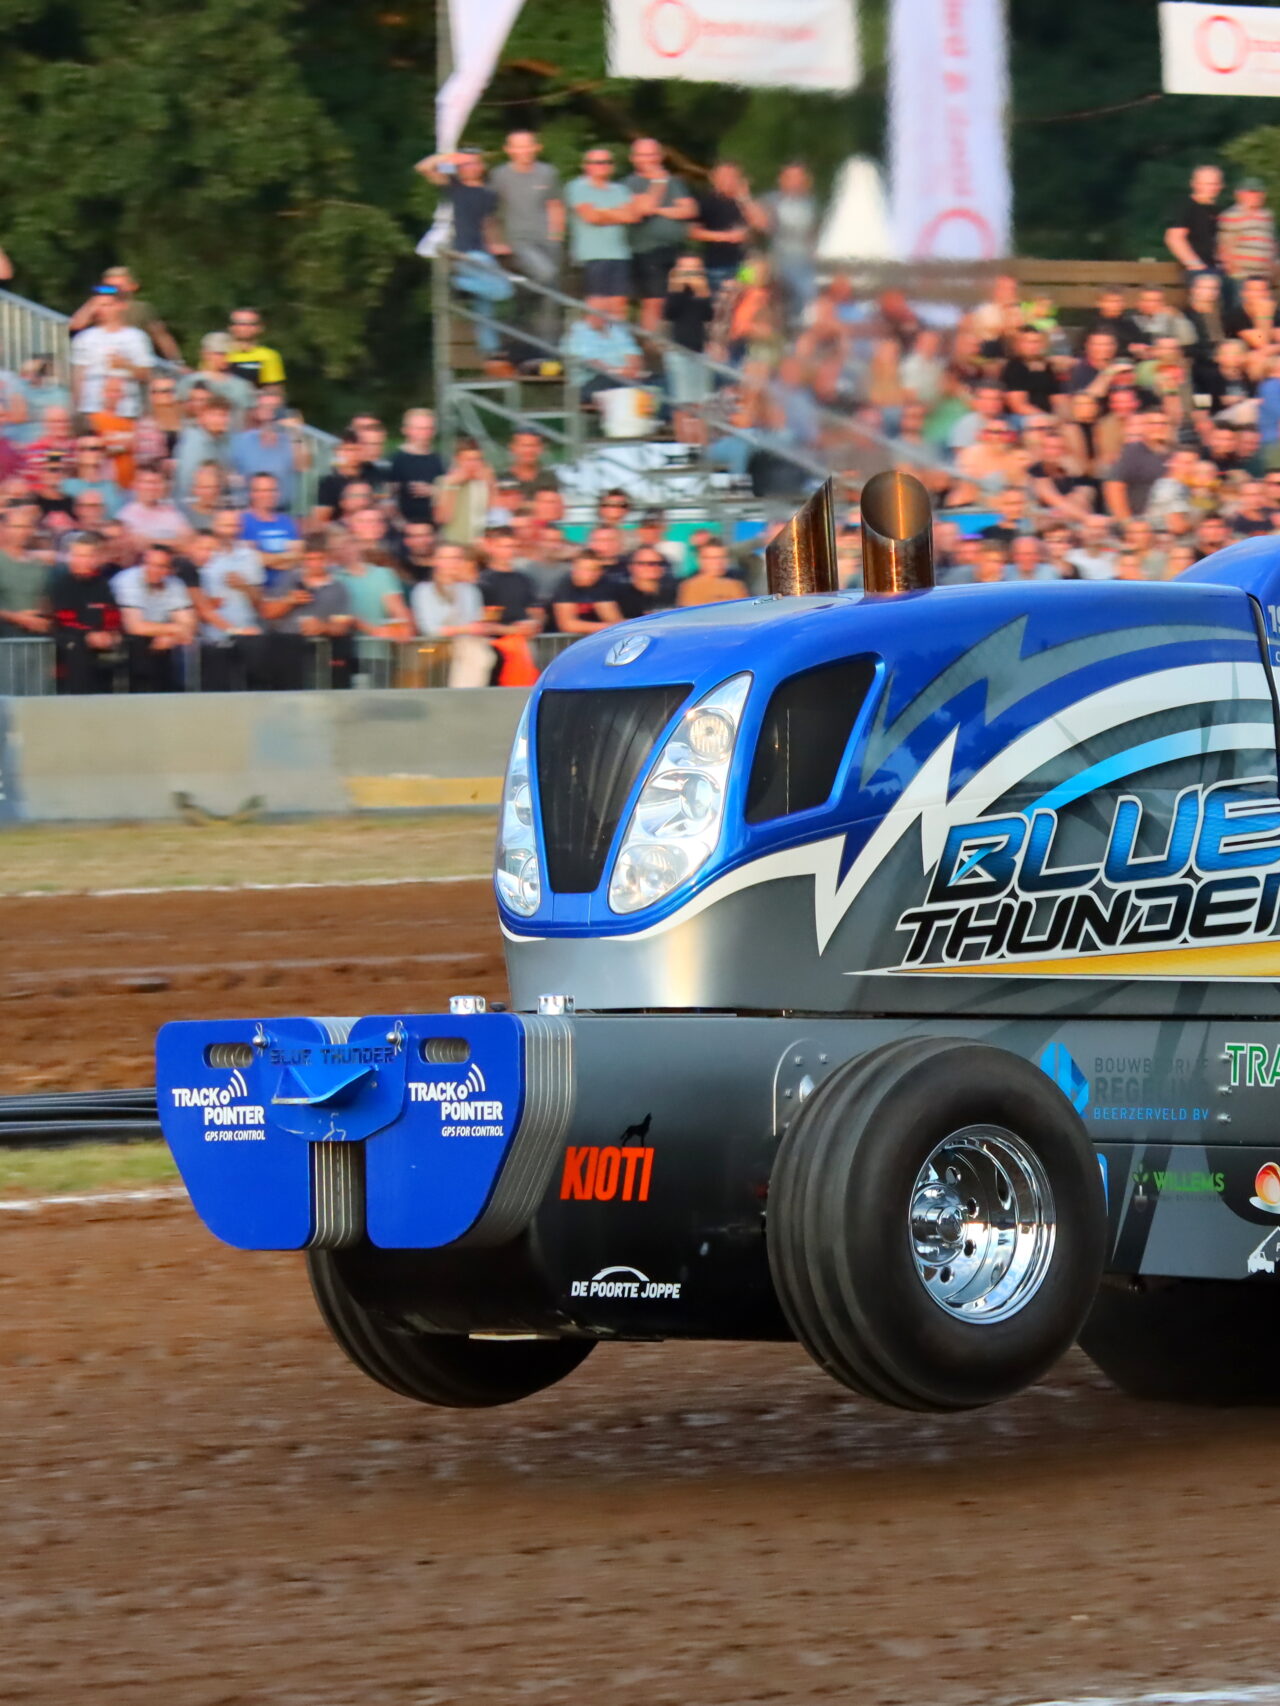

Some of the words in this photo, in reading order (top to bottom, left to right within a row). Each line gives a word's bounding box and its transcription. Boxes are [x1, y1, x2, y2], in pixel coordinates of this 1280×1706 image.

[320, 1046, 394, 1065] THUNDER
[172, 1087, 222, 1107] TRACK
[409, 1082, 458, 1102] TRACK
[203, 1105, 265, 1126] POINTER
[441, 1100, 503, 1121] POINTER
[1093, 1107, 1188, 1121] BEERZERVELD
[1192, 1108, 1210, 1121] BV
[204, 1130, 219, 1142] GPS
[219, 1130, 233, 1142] FOR
[233, 1129, 266, 1142] CONTROL
[441, 1125, 456, 1137] GPS
[456, 1125, 470, 1137] FOR
[470, 1125, 504, 1137] CONTROL
[560, 1145, 655, 1202] KIOTI
[1153, 1171, 1225, 1192] WILLEMS
[571, 1281, 589, 1297] DE
[589, 1282, 640, 1298] POORTE
[640, 1283, 682, 1299] JOPPE
